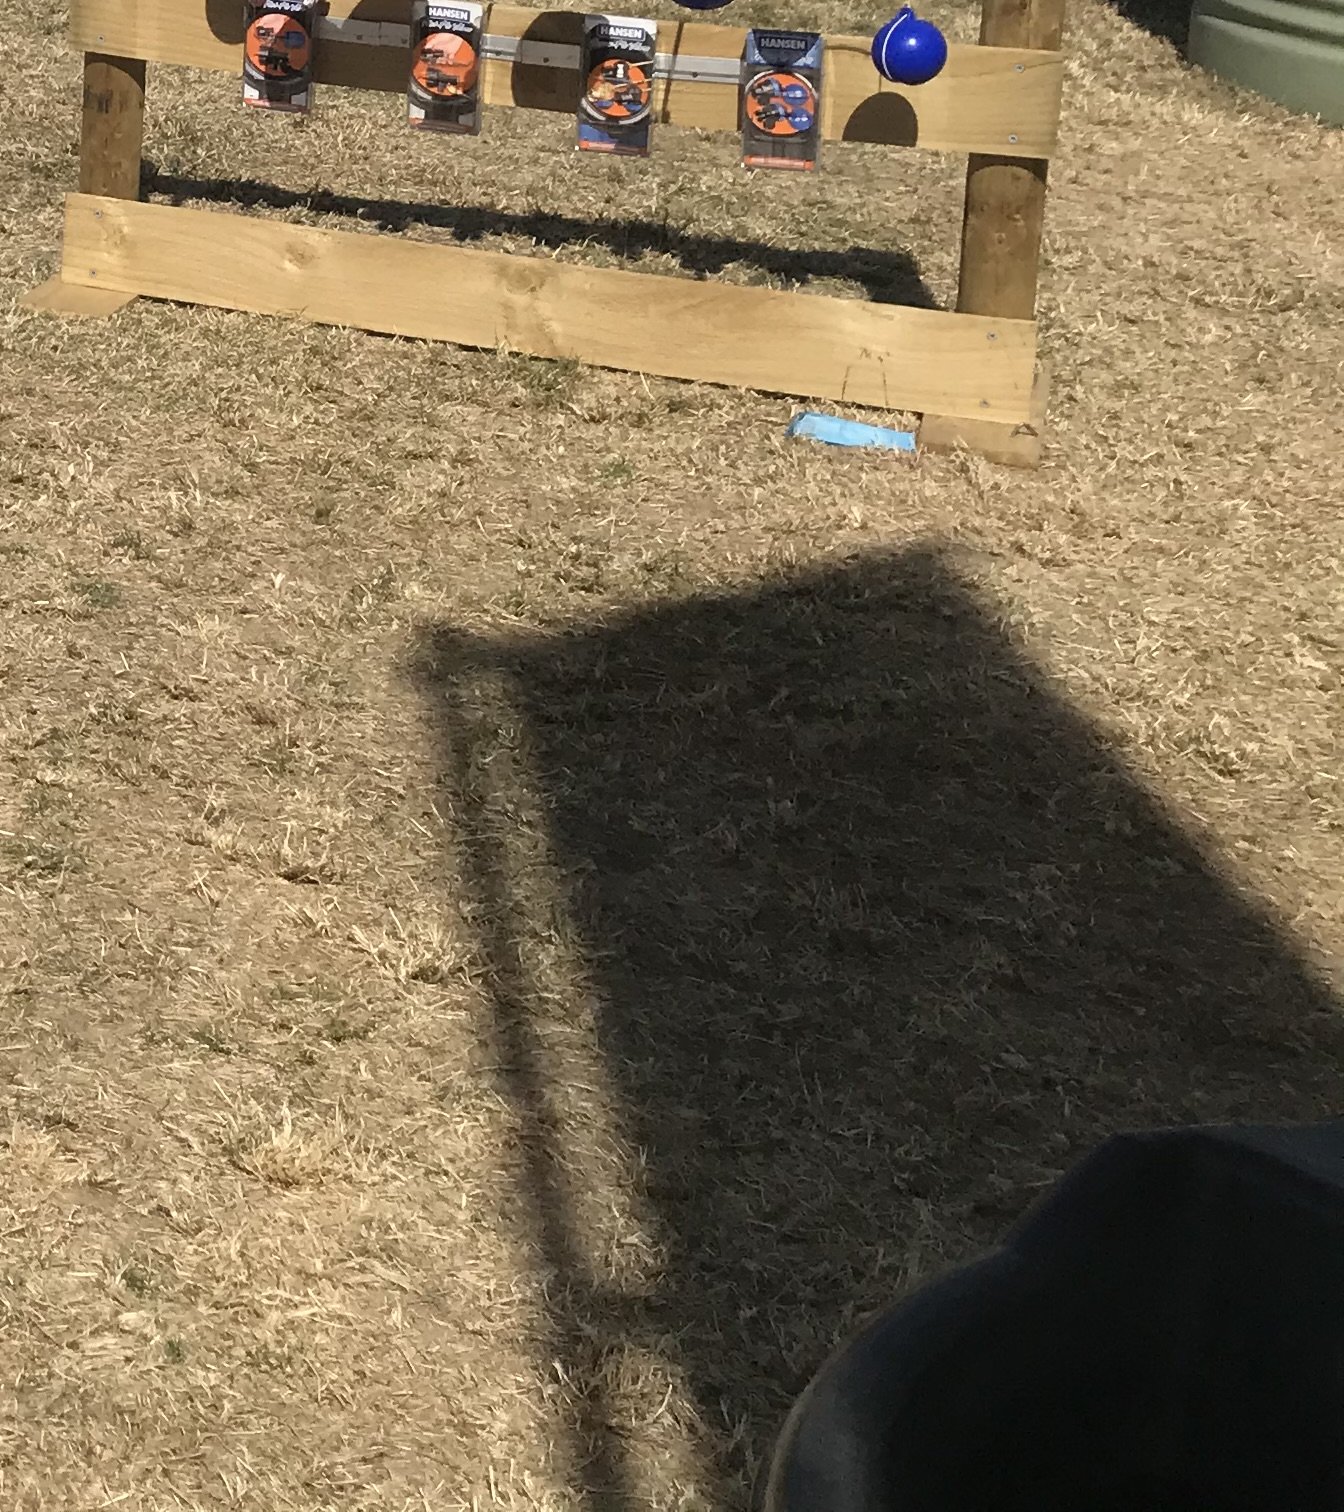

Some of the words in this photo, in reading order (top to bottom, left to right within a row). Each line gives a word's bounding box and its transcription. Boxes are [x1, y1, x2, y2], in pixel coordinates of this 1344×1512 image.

[428, 7, 468, 20] HANSEN
[600, 26, 643, 39] HANSEN
[760, 38, 806, 49] HANSEN
